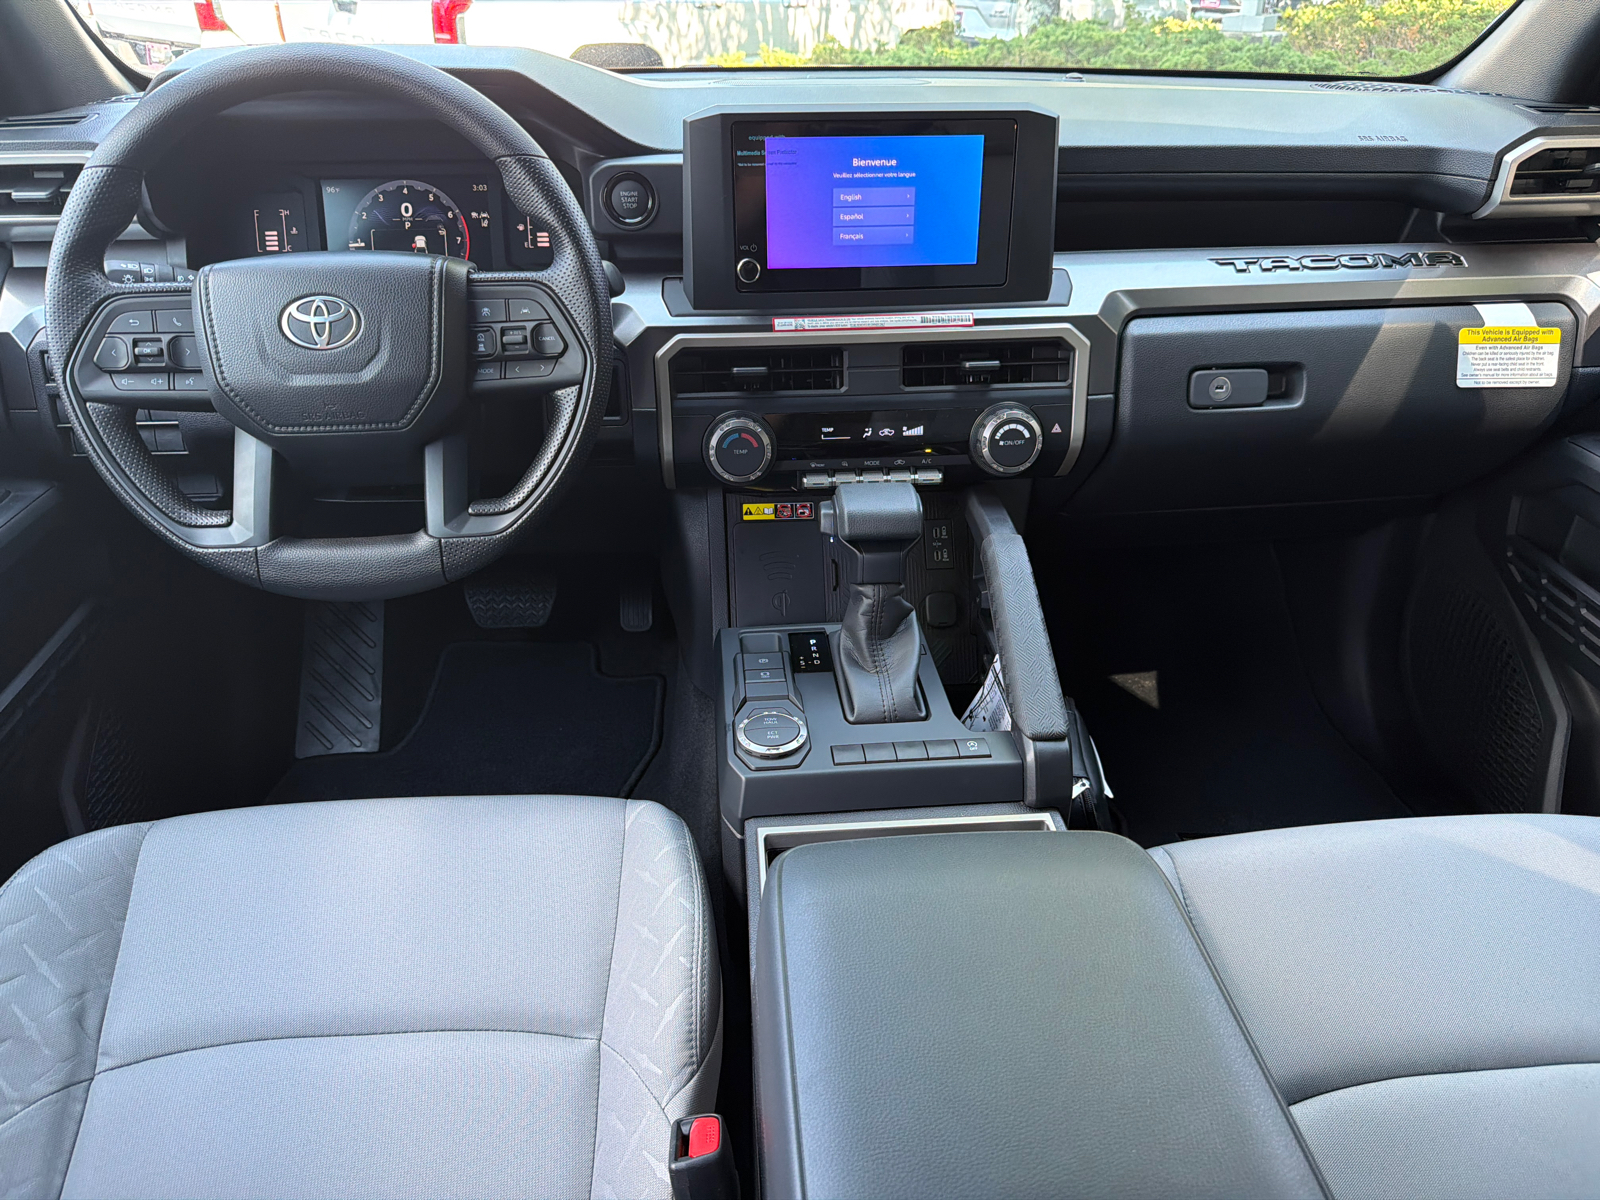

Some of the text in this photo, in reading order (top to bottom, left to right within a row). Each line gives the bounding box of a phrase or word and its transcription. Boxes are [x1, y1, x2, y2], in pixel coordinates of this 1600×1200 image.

[852, 158, 897, 166] Bienvenue
[401, 202, 413, 217] 0
[1207, 250, 1468, 273] TACOMA
